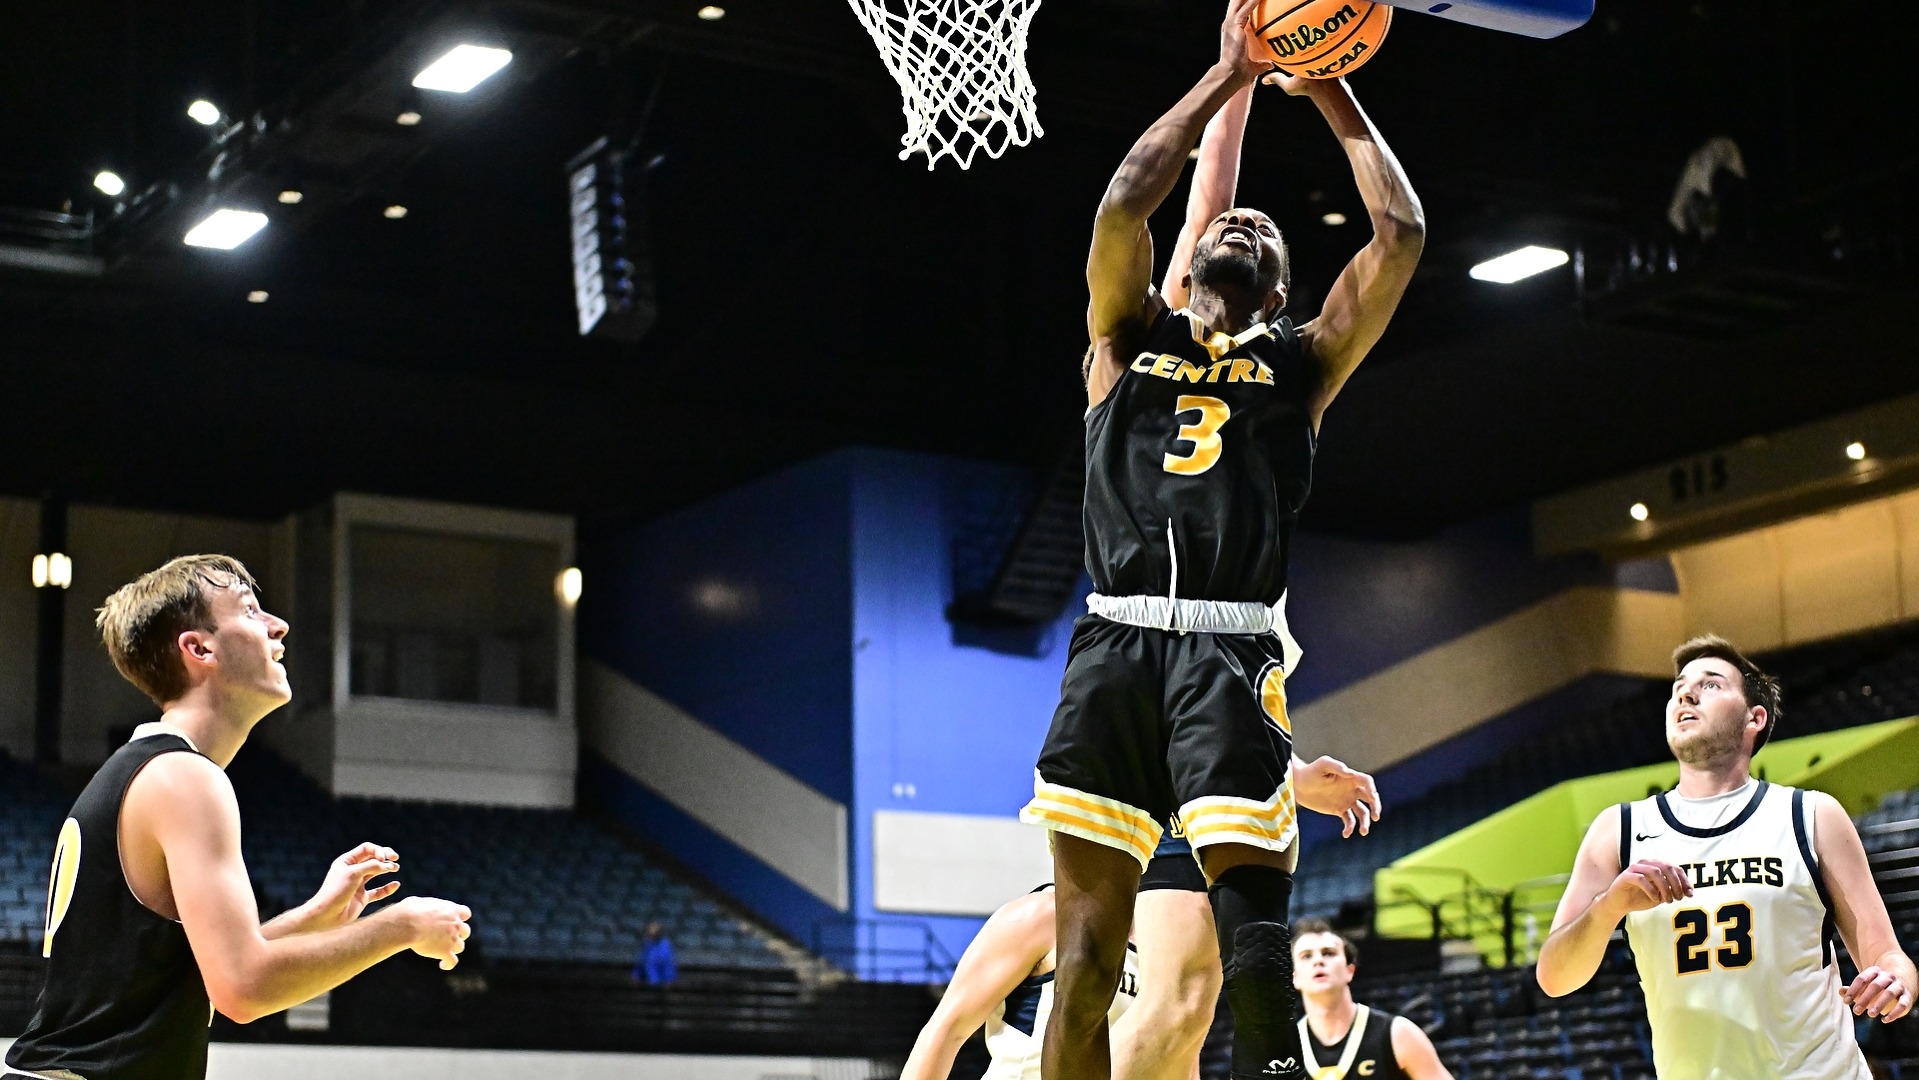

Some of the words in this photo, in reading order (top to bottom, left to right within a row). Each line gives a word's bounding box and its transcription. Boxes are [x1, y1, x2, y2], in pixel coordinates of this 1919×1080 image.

[1267, 4, 1357, 57] Wilson
[1305, 41, 1369, 77] NCAA
[1130, 352, 1275, 386] CENTRE
[1163, 394, 1231, 476] 3
[1672, 901, 1755, 976] 23
[1358, 1059, 1376, 1076] C
